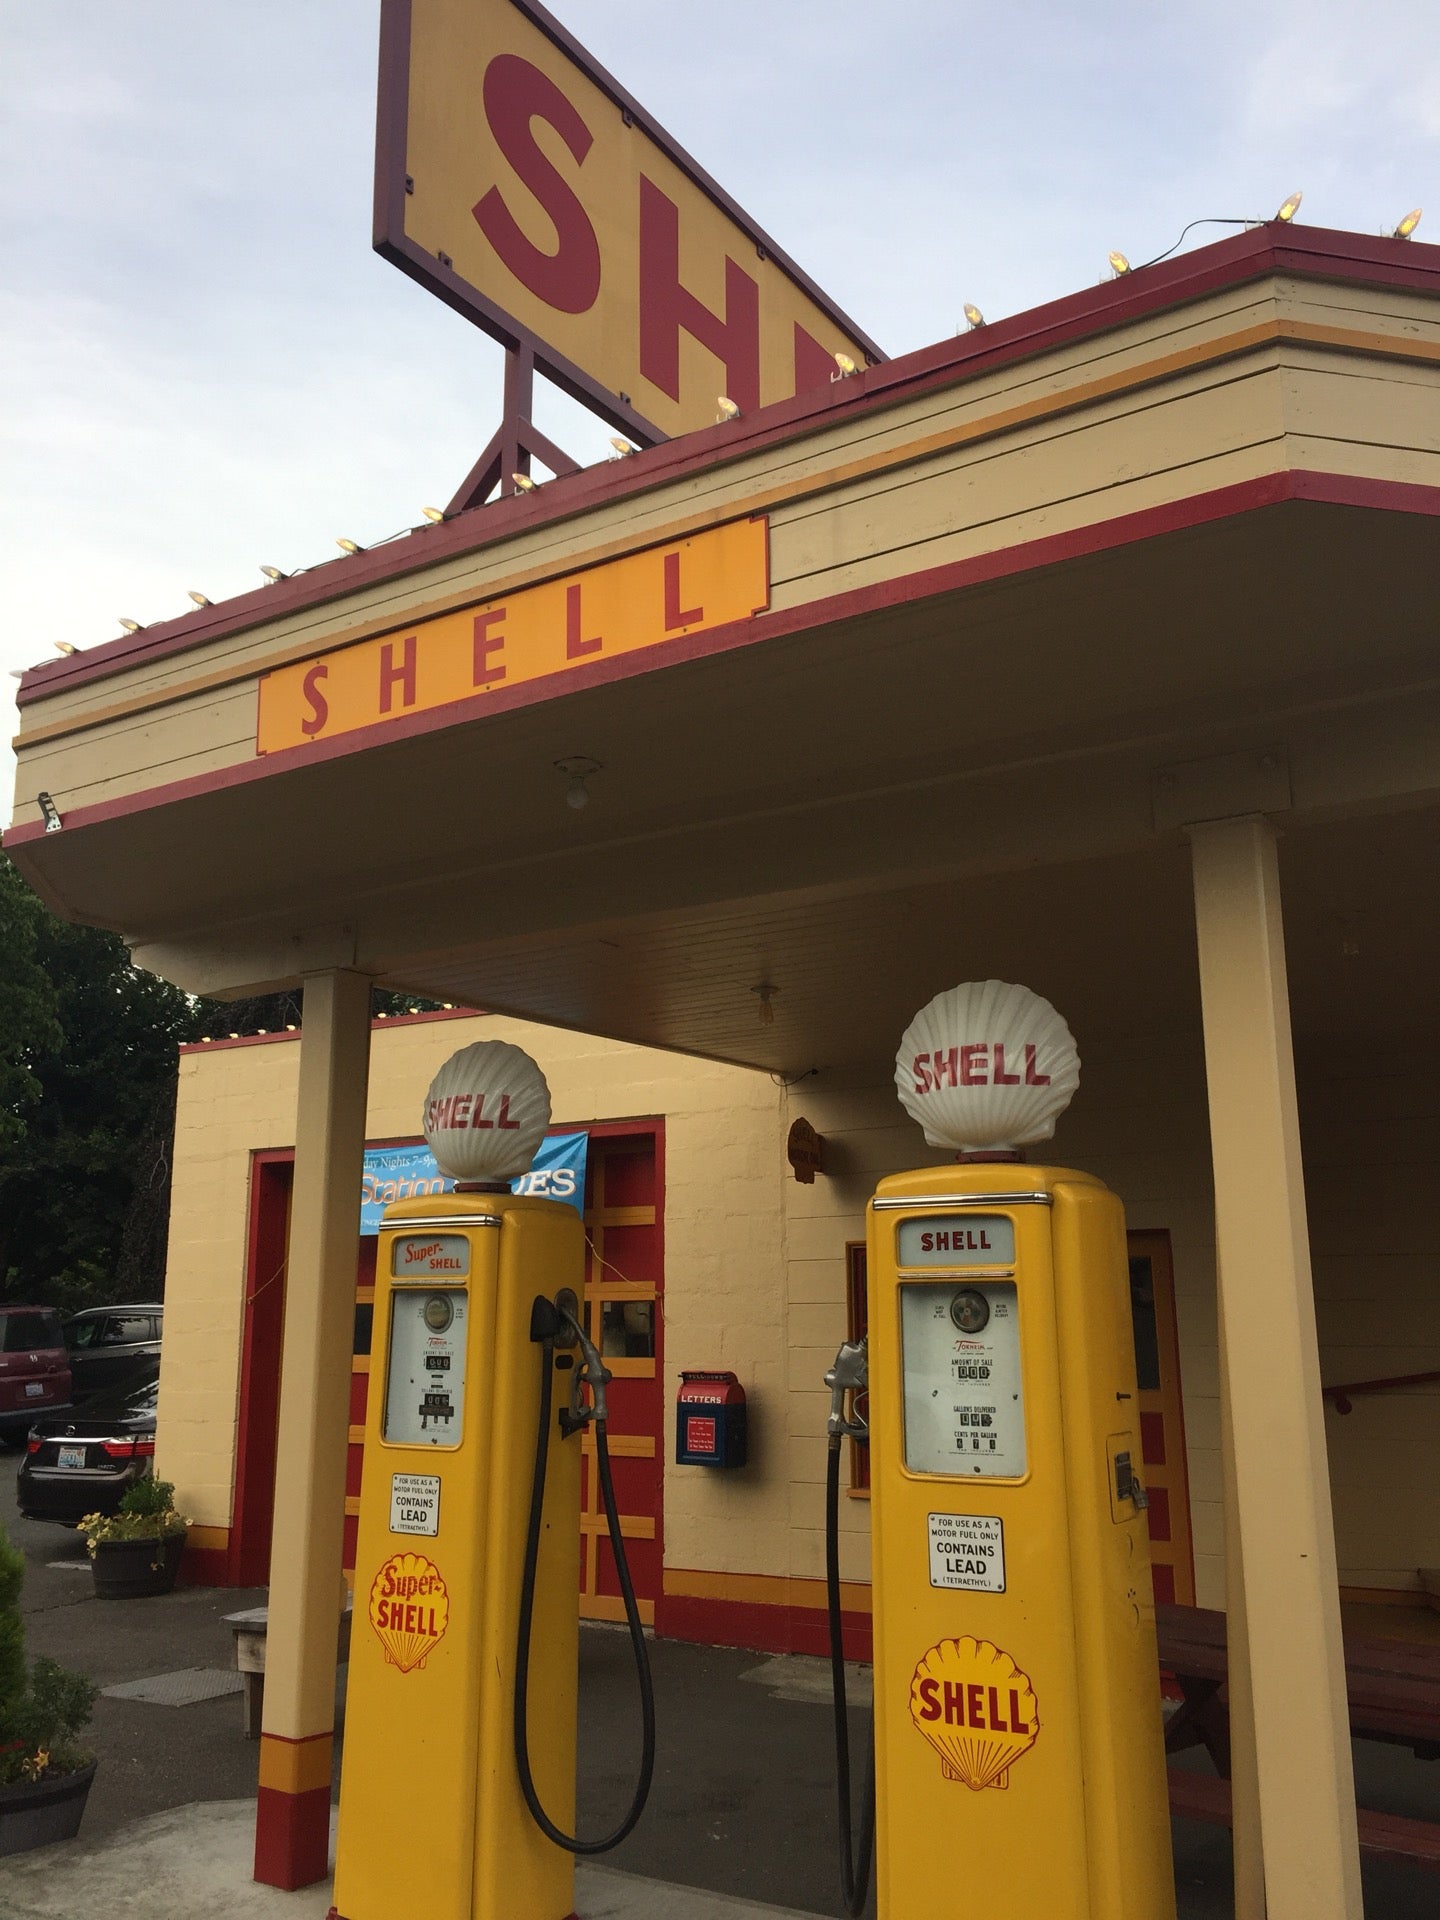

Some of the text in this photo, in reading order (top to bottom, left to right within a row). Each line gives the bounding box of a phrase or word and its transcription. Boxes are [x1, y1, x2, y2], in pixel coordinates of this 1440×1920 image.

[471, 53, 838, 410] SH
[301, 551, 704, 736] SHELL
[912, 1042, 1051, 1094] SHELL
[428, 1093, 521, 1133] SHELL
[381, 1155, 410, 1170] Nights
[362, 1172, 444, 1205] Station
[920, 1229, 991, 1251] SHELL
[429, 1258, 462, 1269] SHELL
[951, 1358, 972, 1366] AMOUNT
[981, 1359, 993, 1367] SALE
[681, 1395, 722, 1404] LETTERS
[970, 1431, 979, 1439] PER
[396, 1496, 434, 1508] CONTAINS
[400, 1509, 427, 1522] LEAD
[938, 1518, 991, 1530] FOR USE AS A
[931, 1529, 999, 1541] MOTOR FUEL ONLY
[936, 1542, 995, 1557] CONTAINS
[946, 1558, 987, 1575] LEAD
[376, 1599, 438, 1638] SHELL
[919, 1678, 1030, 1735] SHELL
